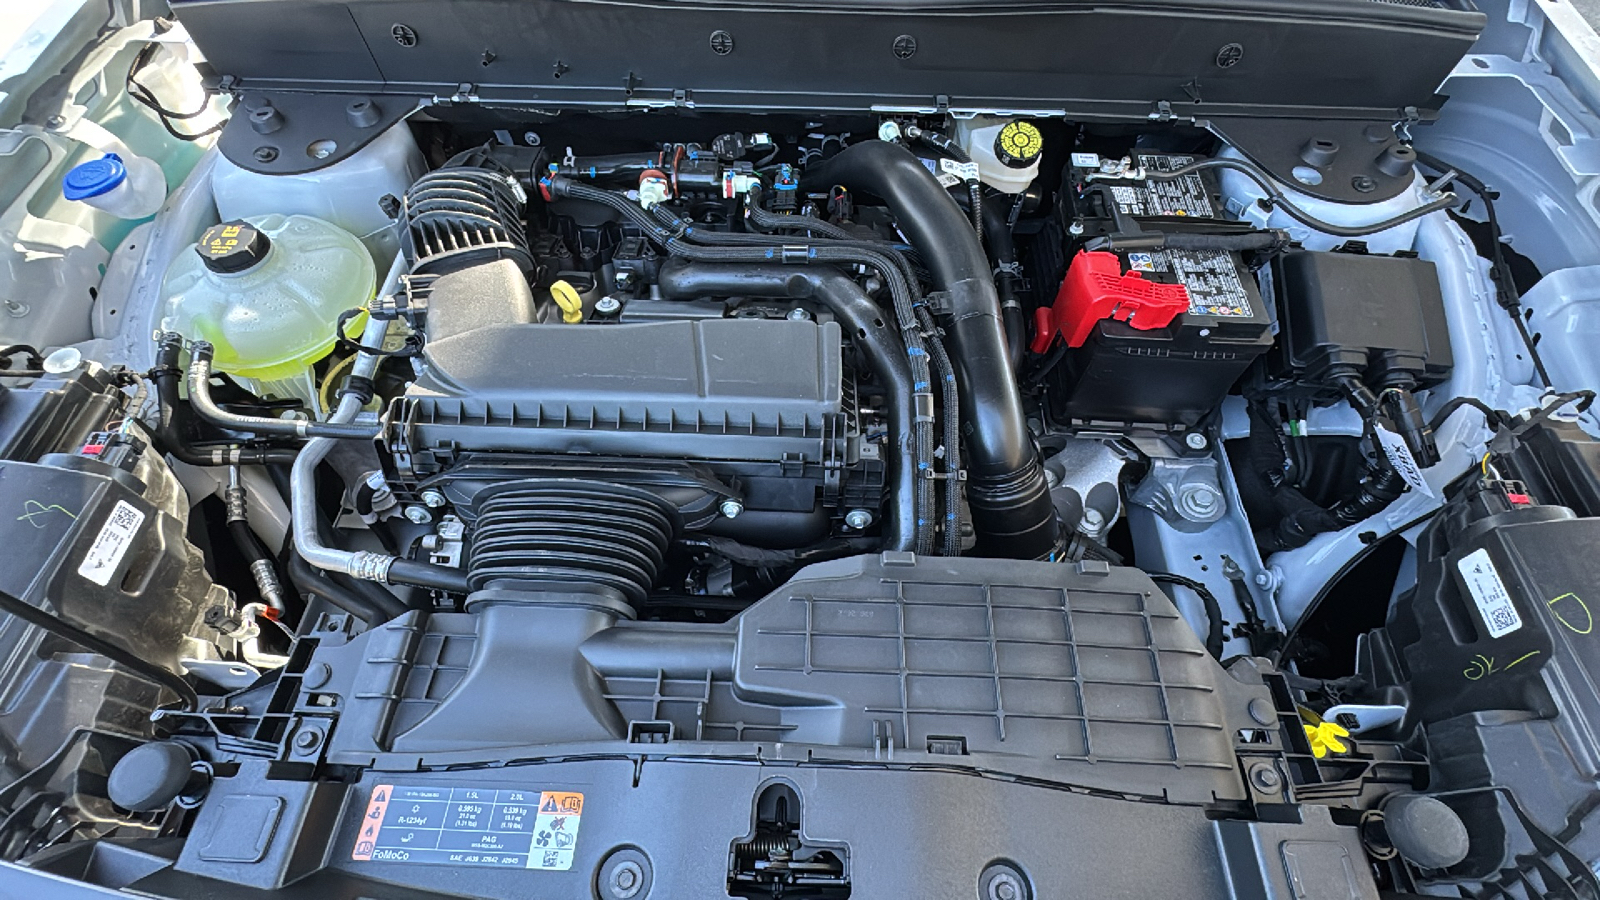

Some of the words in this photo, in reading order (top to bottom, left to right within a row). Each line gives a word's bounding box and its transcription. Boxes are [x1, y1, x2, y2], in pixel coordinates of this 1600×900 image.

[466, 791, 479, 799] 1.5L
[510, 793, 524, 801] 2.0L
[474, 805, 482, 814] kg
[519, 806, 527, 816] kg
[398, 816, 428, 826] R-1234yf
[481, 835, 497, 843] PAG
[372, 849, 409, 860] FoMoCo
